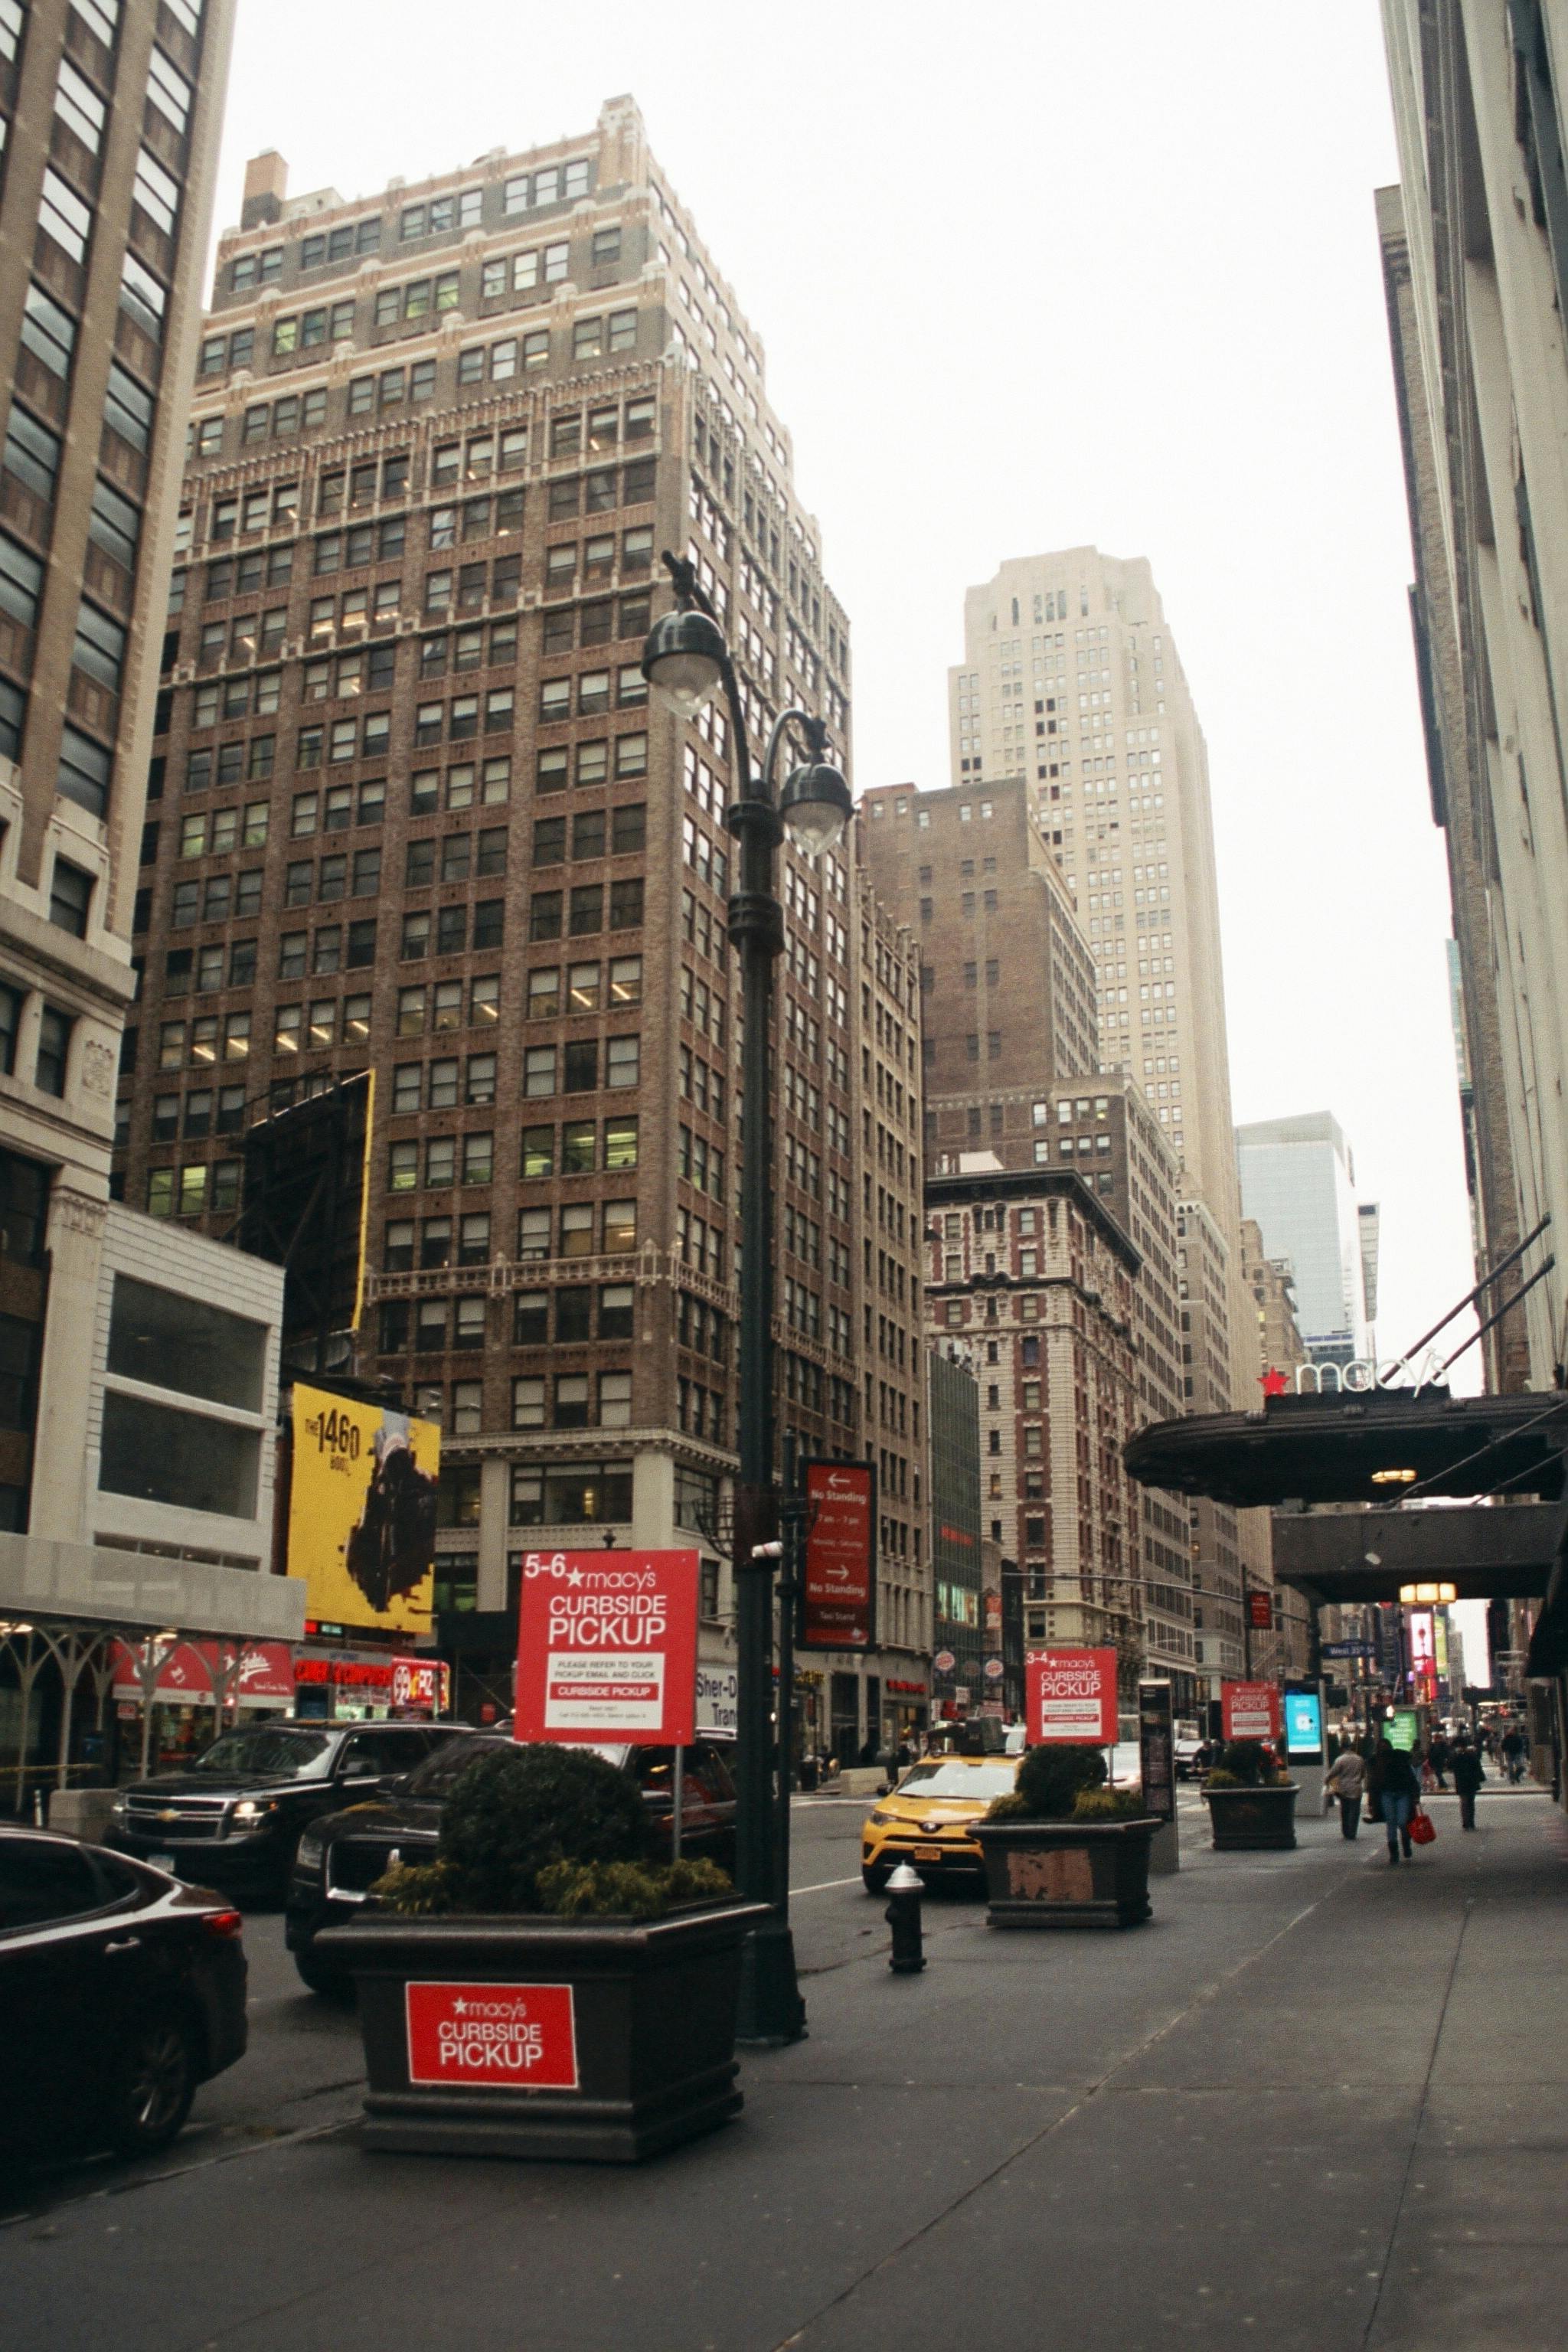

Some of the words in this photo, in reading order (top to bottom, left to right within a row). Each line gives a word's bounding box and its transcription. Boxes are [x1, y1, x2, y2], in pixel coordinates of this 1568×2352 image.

[317, 1408, 360, 1462] 1460
[811, 1490, 825, 1499] No
[826, 1490, 867, 1505] Standing
[524, 1553, 566, 1577] 5-6
[586, 1564, 656, 1592] macy's
[809, 1583, 823, 1592] No
[825, 1583, 867, 1598] Standing
[549, 1595, 667, 1615] CURBSIDE
[548, 1617, 666, 1645] PICKUP
[1027, 1651, 1047, 1664] 3-4
[1059, 1656, 1096, 1669] macy's
[554, 1671, 583, 1679] PICKUP
[586, 1671, 609, 1679] EMAIL
[612, 1671, 629, 1679] AND
[631, 1671, 655, 1679] CLICK
[1041, 1670, 1102, 1682] CURBSIDE
[557, 1686, 610, 1697] CURBSIDE
[612, 1686, 651, 1697] PICKUP
[697, 1673, 738, 1698] Sher-D
[1041, 1681, 1102, 1696] PICKUP
[712, 1702, 737, 1726] Tran
[1231, 1701, 1269, 1710] PICKUP
[469, 1997, 527, 2020] macy's
[438, 2021, 542, 2043] CURBSIDE
[439, 2042, 543, 2068] PICKUP
